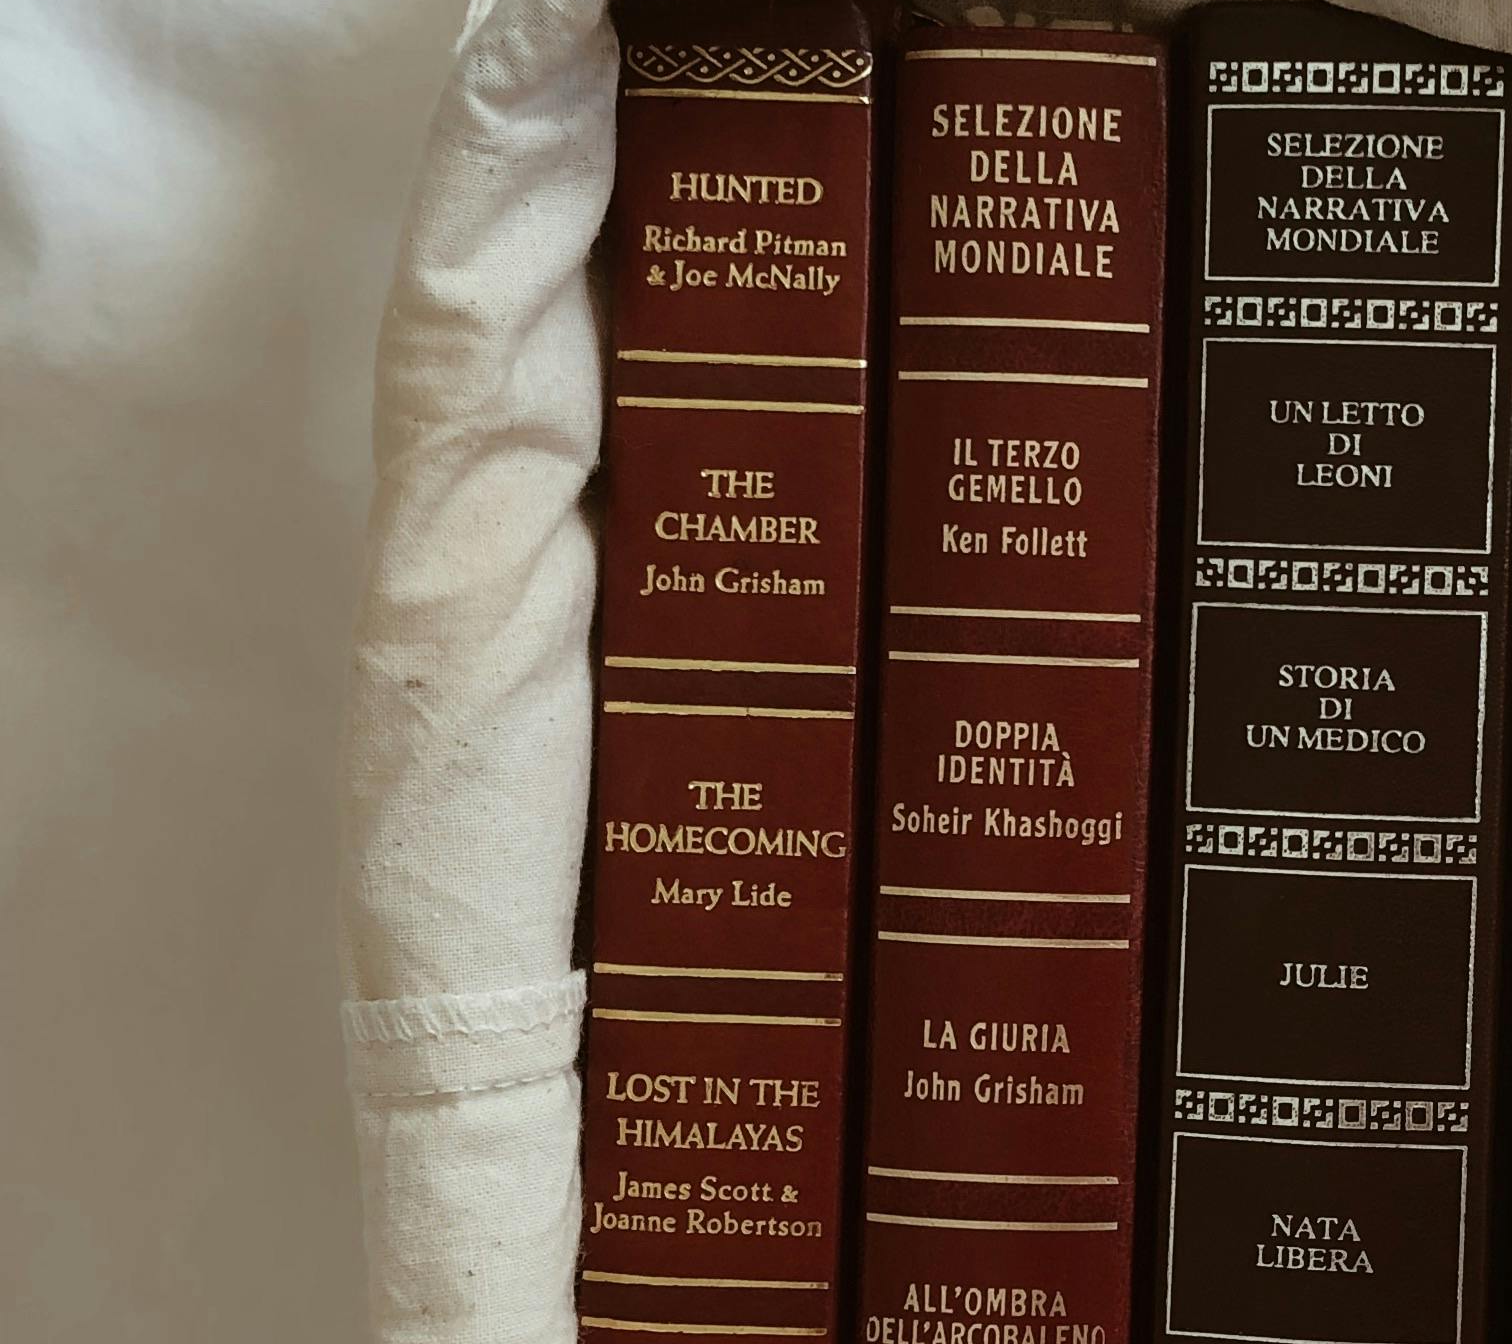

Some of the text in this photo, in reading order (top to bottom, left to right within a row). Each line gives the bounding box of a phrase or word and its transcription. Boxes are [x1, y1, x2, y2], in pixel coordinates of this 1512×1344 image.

[932, 104, 1121, 142] SELEZIONE
[1268, 133, 1443, 159] SELEZIONE
[971, 150, 1077, 185] DELLA
[1302, 166, 1406, 190] DELLA
[670, 172, 823, 204] HUNTED
[931, 195, 1119, 233] NARRATIVA
[1258, 196, 1449, 222] NARRATIVA
[643, 225, 846, 256] Richard Pitman
[1267, 228, 1438, 254] MONDIALE
[936, 240, 1113, 278] MONDIALE
[647, 260, 840, 295] & Joe McNally
[1270, 401, 1424, 426] UN LETTO
[954, 439, 1079, 469] IL TERZO
[1328, 433, 1361, 455] DI
[701, 469, 774, 498] THE
[949, 474, 1081, 505] GEMELLO
[1297, 464, 1392, 487] LEONI
[655, 511, 820, 544] CHAMBER
[943, 524, 1087, 557] Ken Follett
[640, 565, 824, 595] John Grisham
[1279, 665, 1395, 691] STORIA
[1320, 698, 1352, 720] DI
[956, 720, 1059, 751] DOPPIA
[1247, 725, 1425, 753] UN MEDICO
[939, 752, 1074, 786] IDENTITÀ
[688, 781, 762, 810] THE
[605, 822, 846, 857] HOMECOMING
[892, 803, 1122, 845] Soheir Khashoggi
[651, 878, 791, 910] Mary Lide
[1280, 963, 1368, 989] JULIE
[924, 1020, 1070, 1053] LA GIURIA
[606, 1072, 820, 1107] LOST IN THE
[904, 1071, 1083, 1104] John Grisham
[617, 1118, 803, 1152] HIMALAYAS
[613, 1172, 798, 1203] James Scott &
[590, 1202, 821, 1237] Joanne Robertson
[1272, 1214, 1360, 1241] NATA
[1257, 1244, 1373, 1273] LIBERA
[904, 1284, 1066, 1316] ALL'OMBRA
